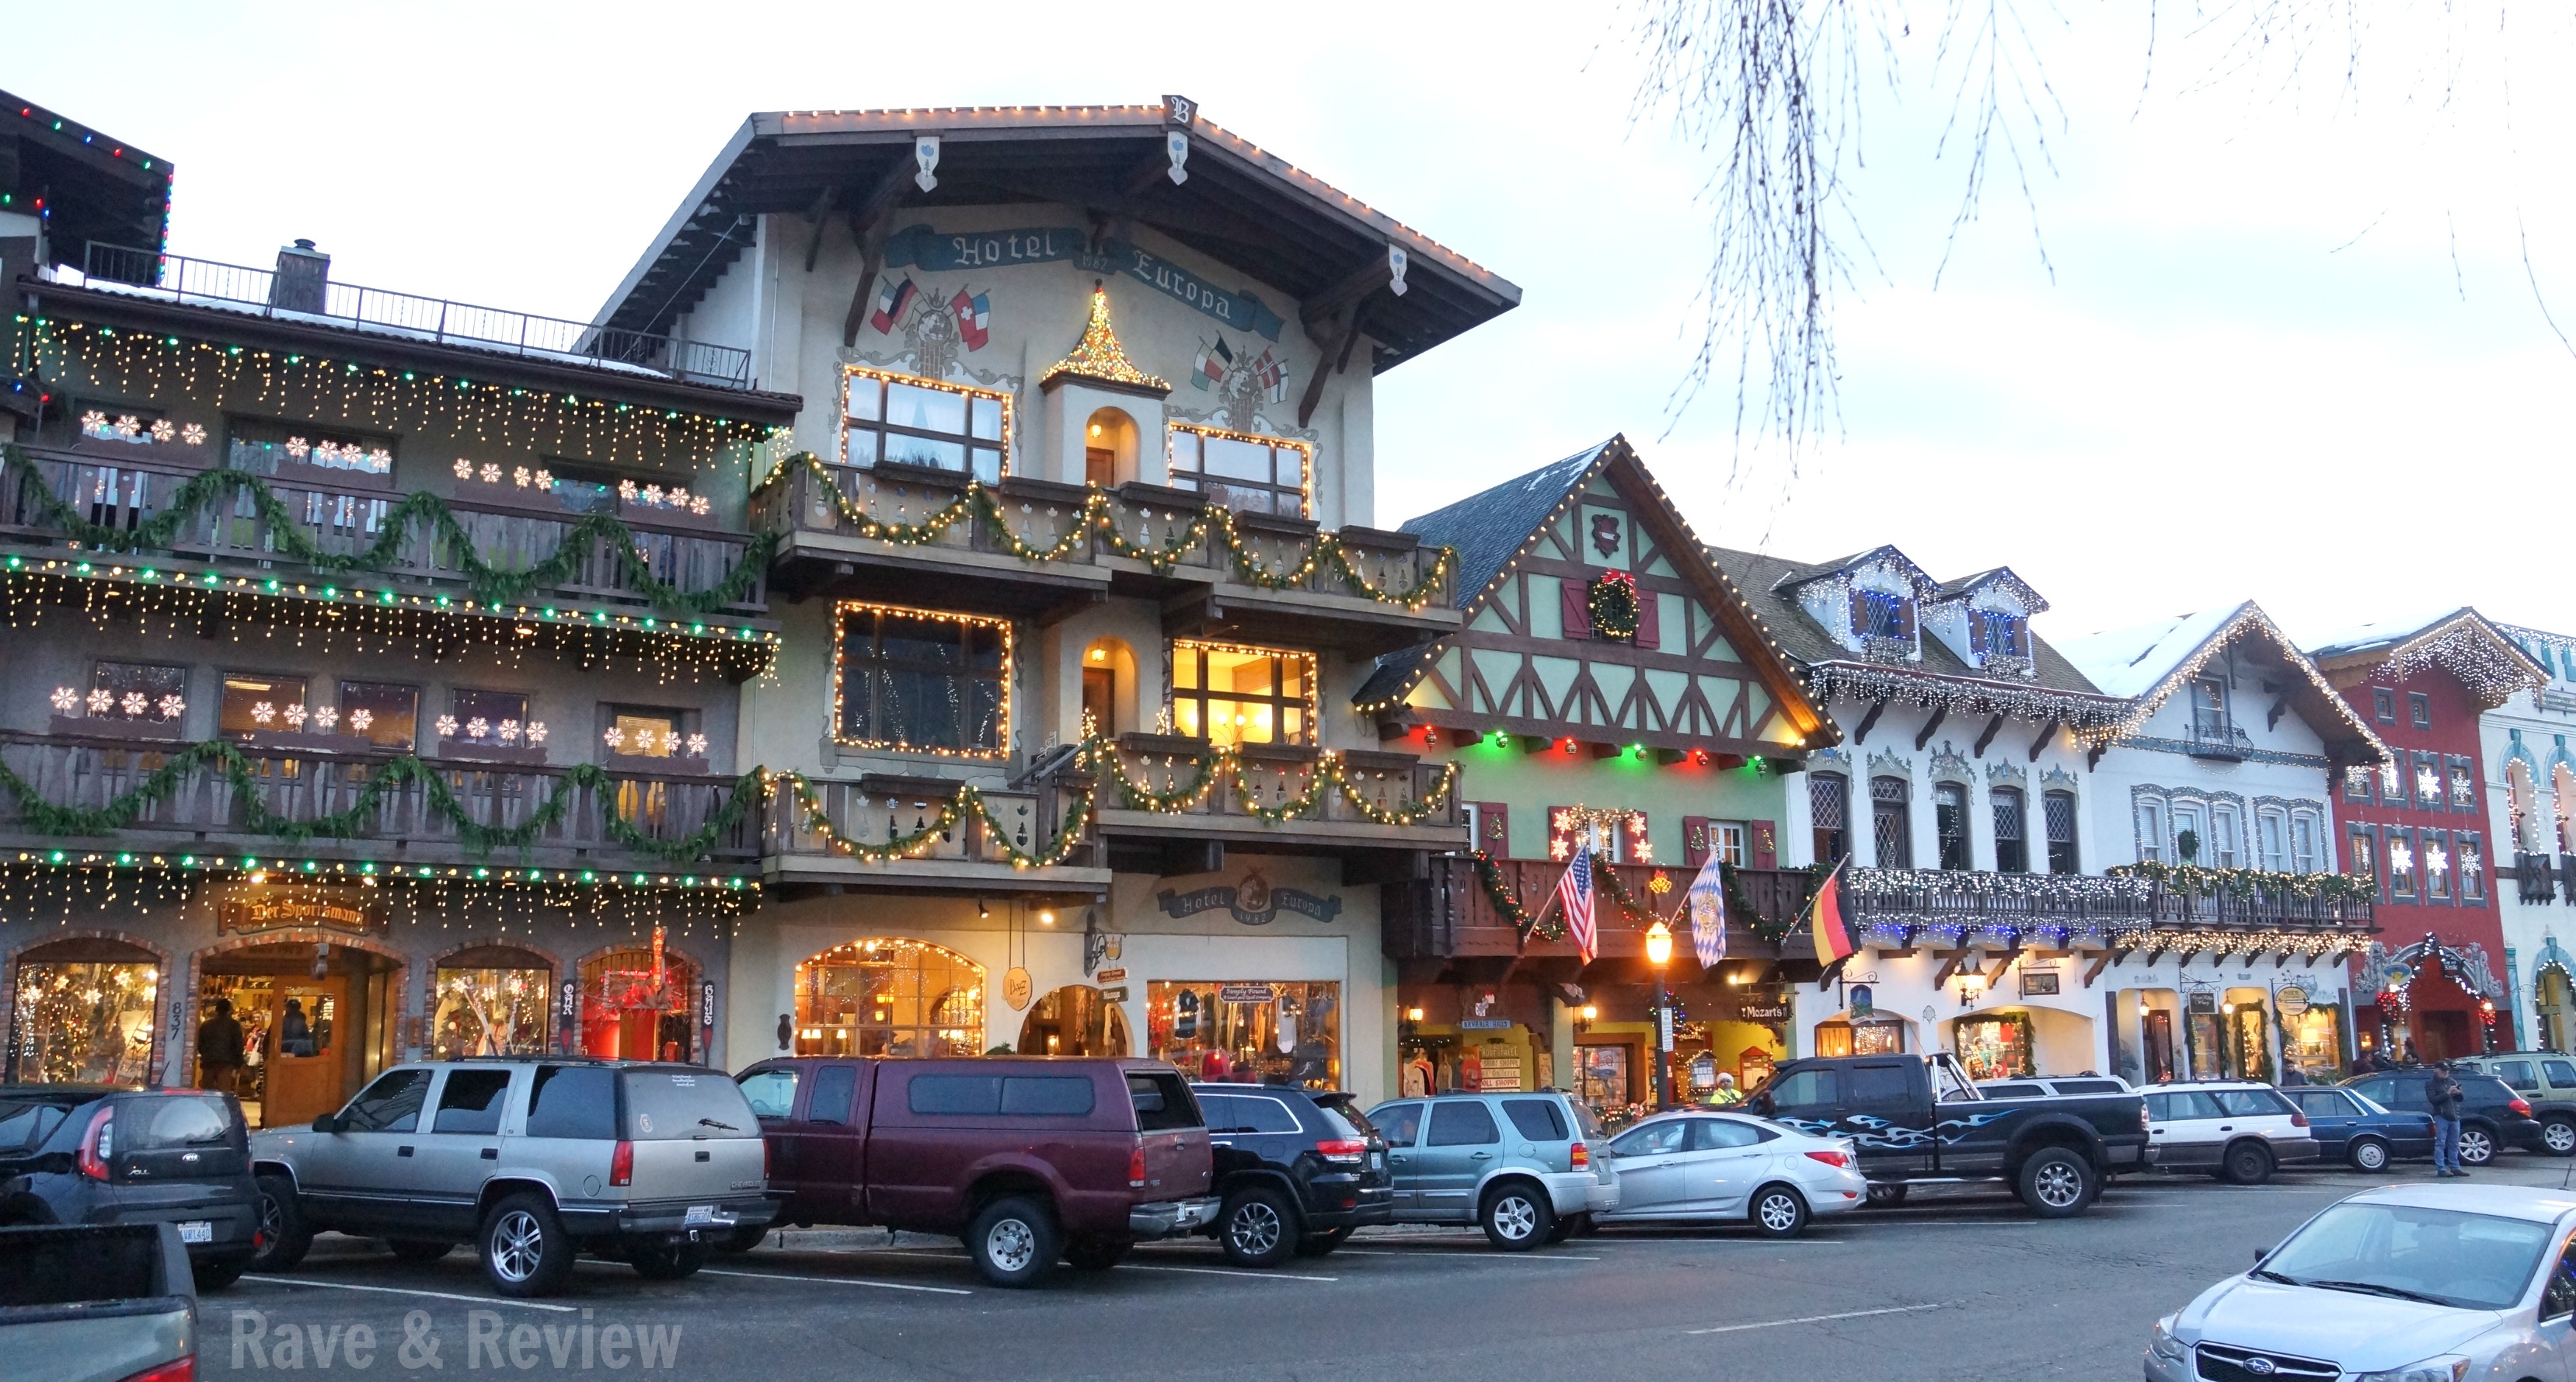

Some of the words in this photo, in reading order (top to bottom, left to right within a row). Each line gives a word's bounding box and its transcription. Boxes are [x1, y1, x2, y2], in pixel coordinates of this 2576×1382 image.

[1171, 96, 1189, 124] B
[953, 231, 1058, 266] Hotel
[1133, 249, 1232, 319] Europa
[251, 903, 279, 921] Der
[281, 898, 364, 924] Sportsmann
[1182, 893, 1225, 913] Hotel
[1282, 893, 1321, 916] Europa
[1240, 913, 1267, 924] 1982
[1226, 987, 1246, 997] Simply
[172, 1002, 182, 1040] 837
[1747, 1006, 1783, 1018] Mozart's
[1495, 1078, 1518, 1087] SHOPPE
